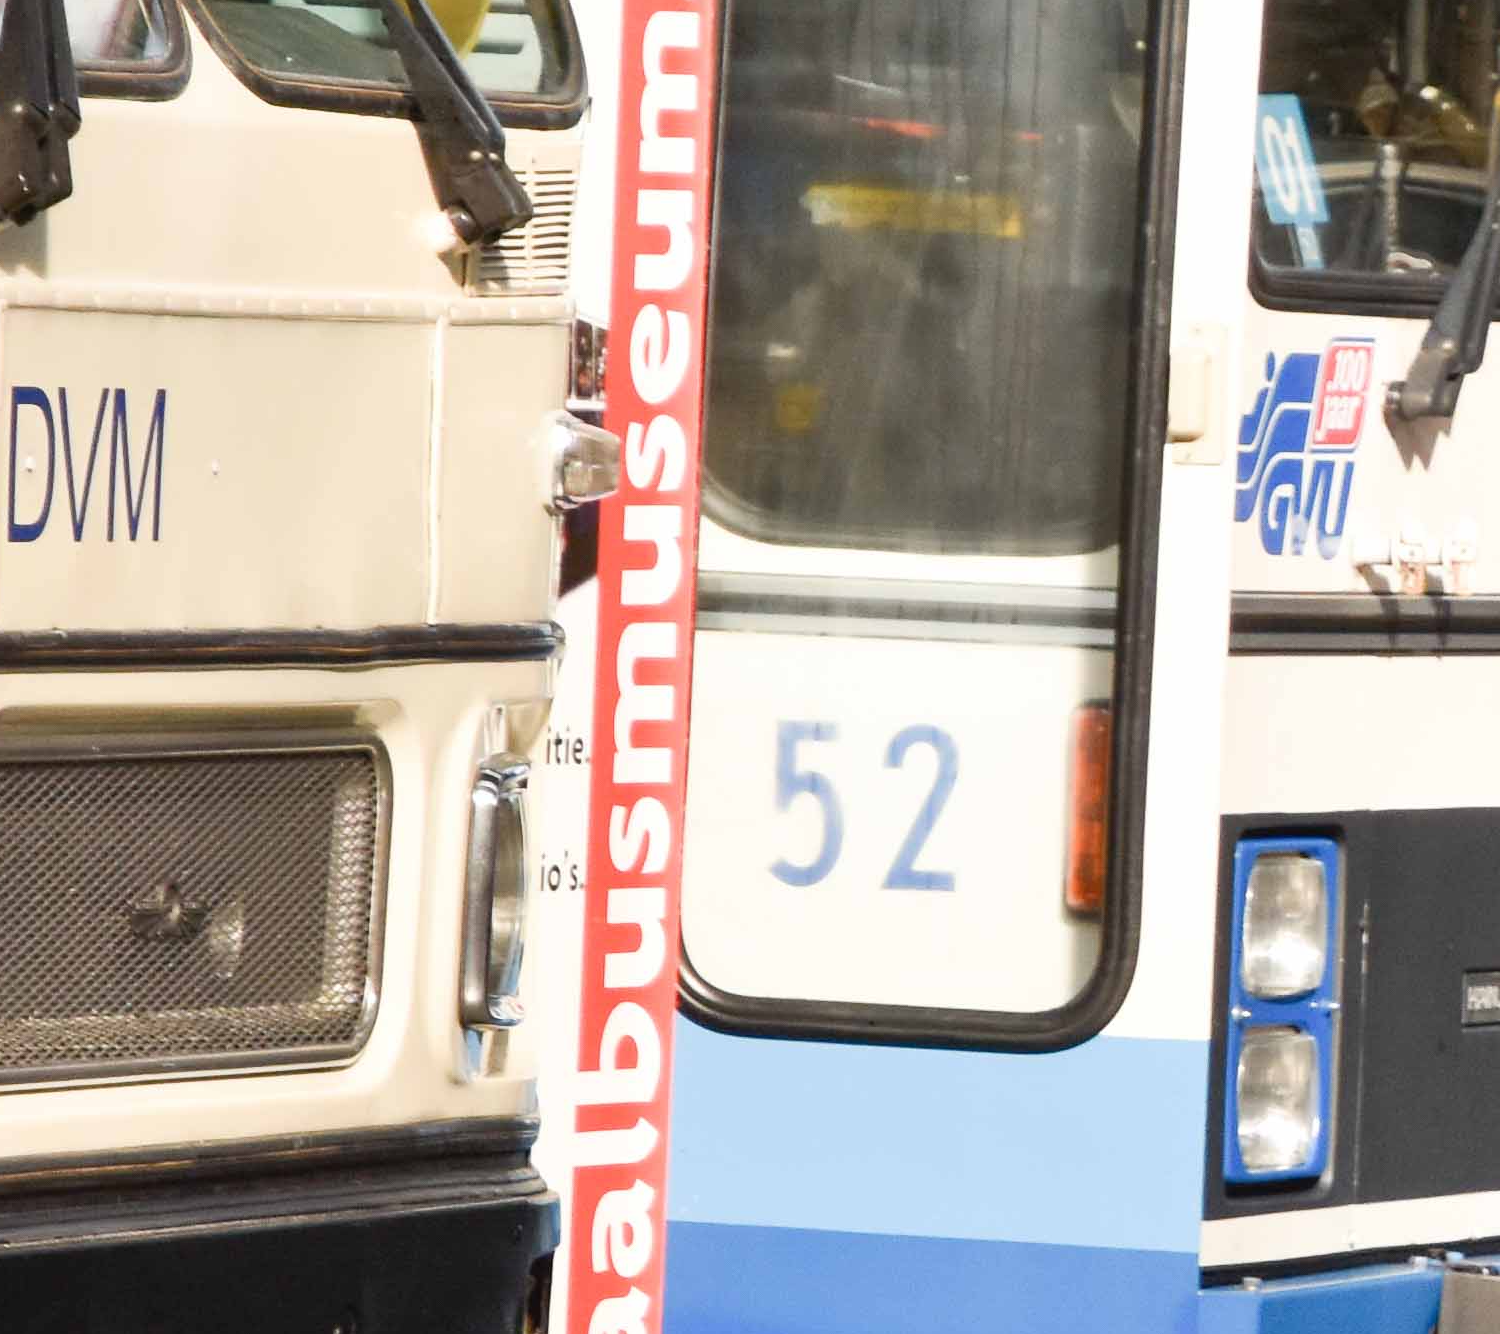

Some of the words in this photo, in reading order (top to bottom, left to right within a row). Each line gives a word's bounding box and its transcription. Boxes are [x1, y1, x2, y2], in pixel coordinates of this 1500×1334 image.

[1327, 349, 1371, 393] 100
[1313, 395, 1363, 443] jaar
[6, 386, 168, 544] DVM
[1259, 458, 1357, 562] GVU
